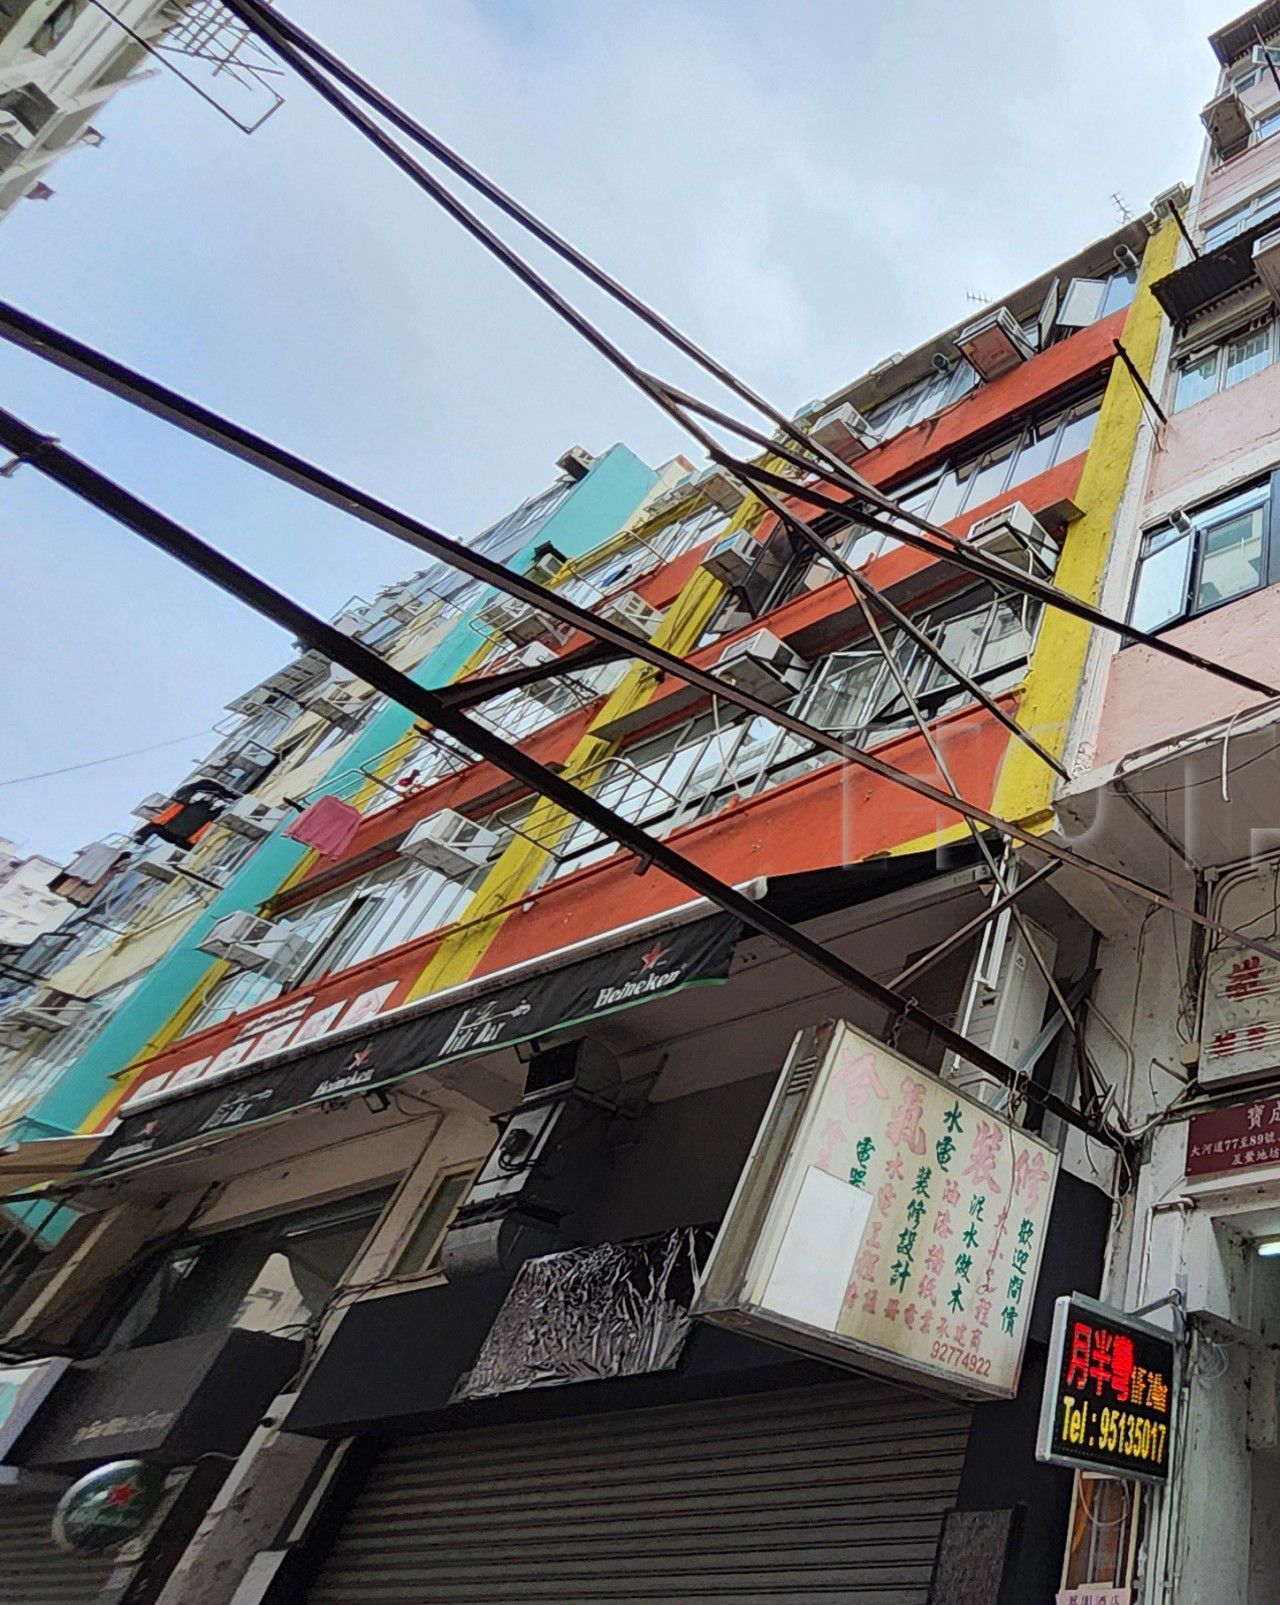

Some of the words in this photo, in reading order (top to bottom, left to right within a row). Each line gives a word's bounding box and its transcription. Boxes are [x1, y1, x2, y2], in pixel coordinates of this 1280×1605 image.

[594, 969, 684, 1009] Heineken
[936, 1101, 964, 1172] 水電
[889, 1166, 932, 1294] 裝修設計
[1001, 1218, 1034, 1338] 歡迎問價
[930, 1340, 991, 1377] 92774922
[1099, 1406, 1166, 1464] 95135017
